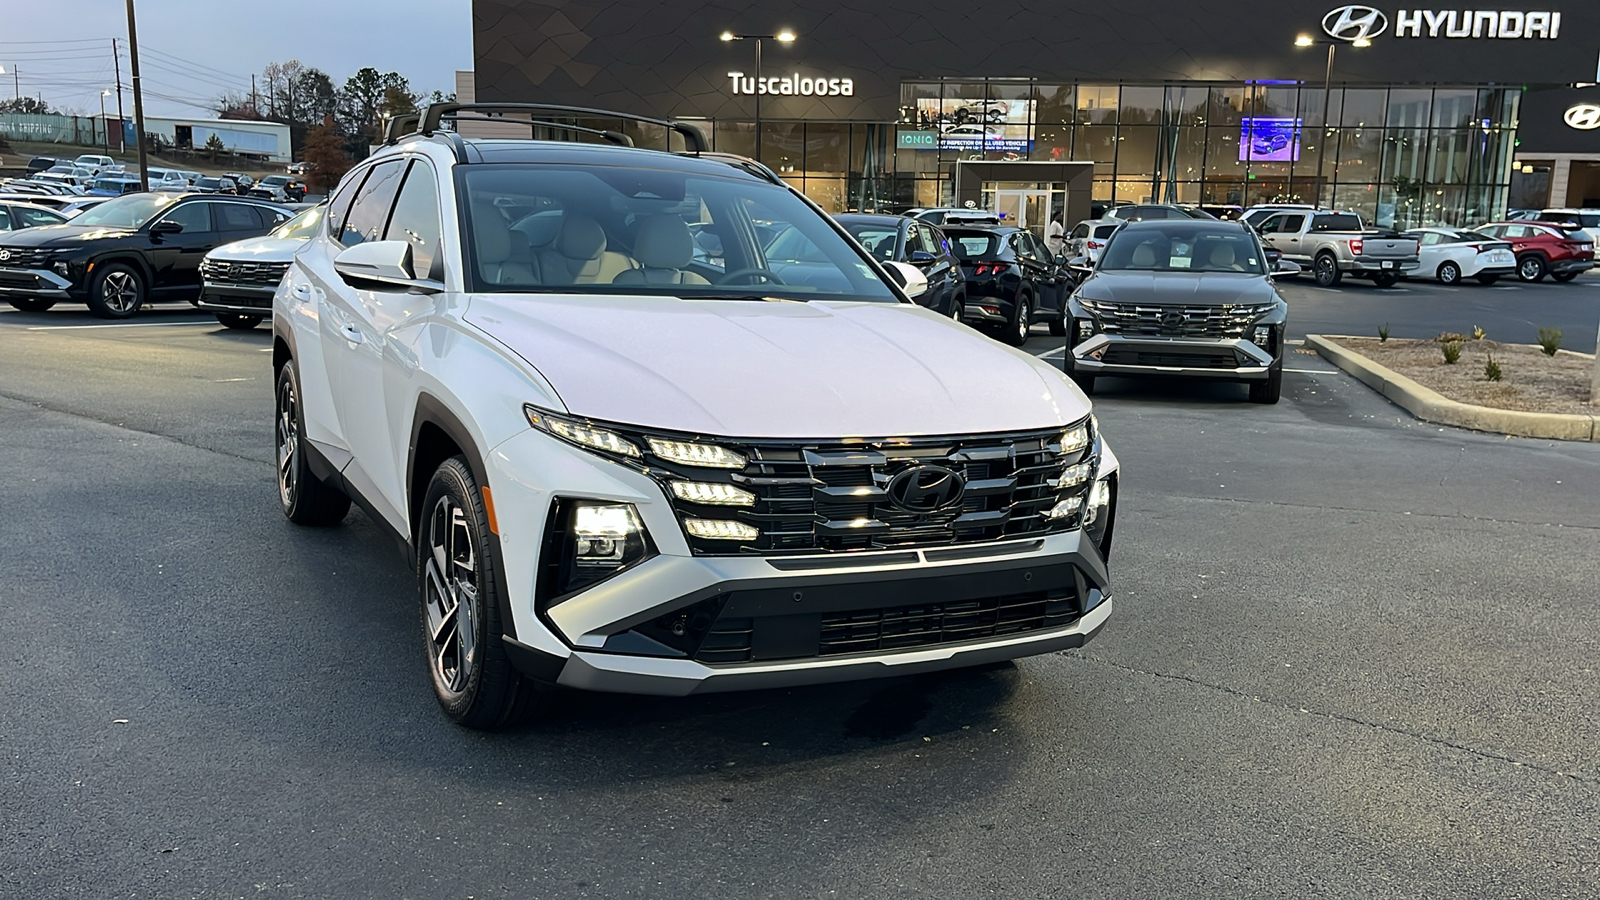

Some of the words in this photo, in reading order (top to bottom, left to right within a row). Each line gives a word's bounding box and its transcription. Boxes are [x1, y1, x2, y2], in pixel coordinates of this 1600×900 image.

[1395, 9, 1561, 39] HYUNDAI
[727, 72, 854, 96] Tuscaloosa
[901, 135, 933, 144] IONIQ
